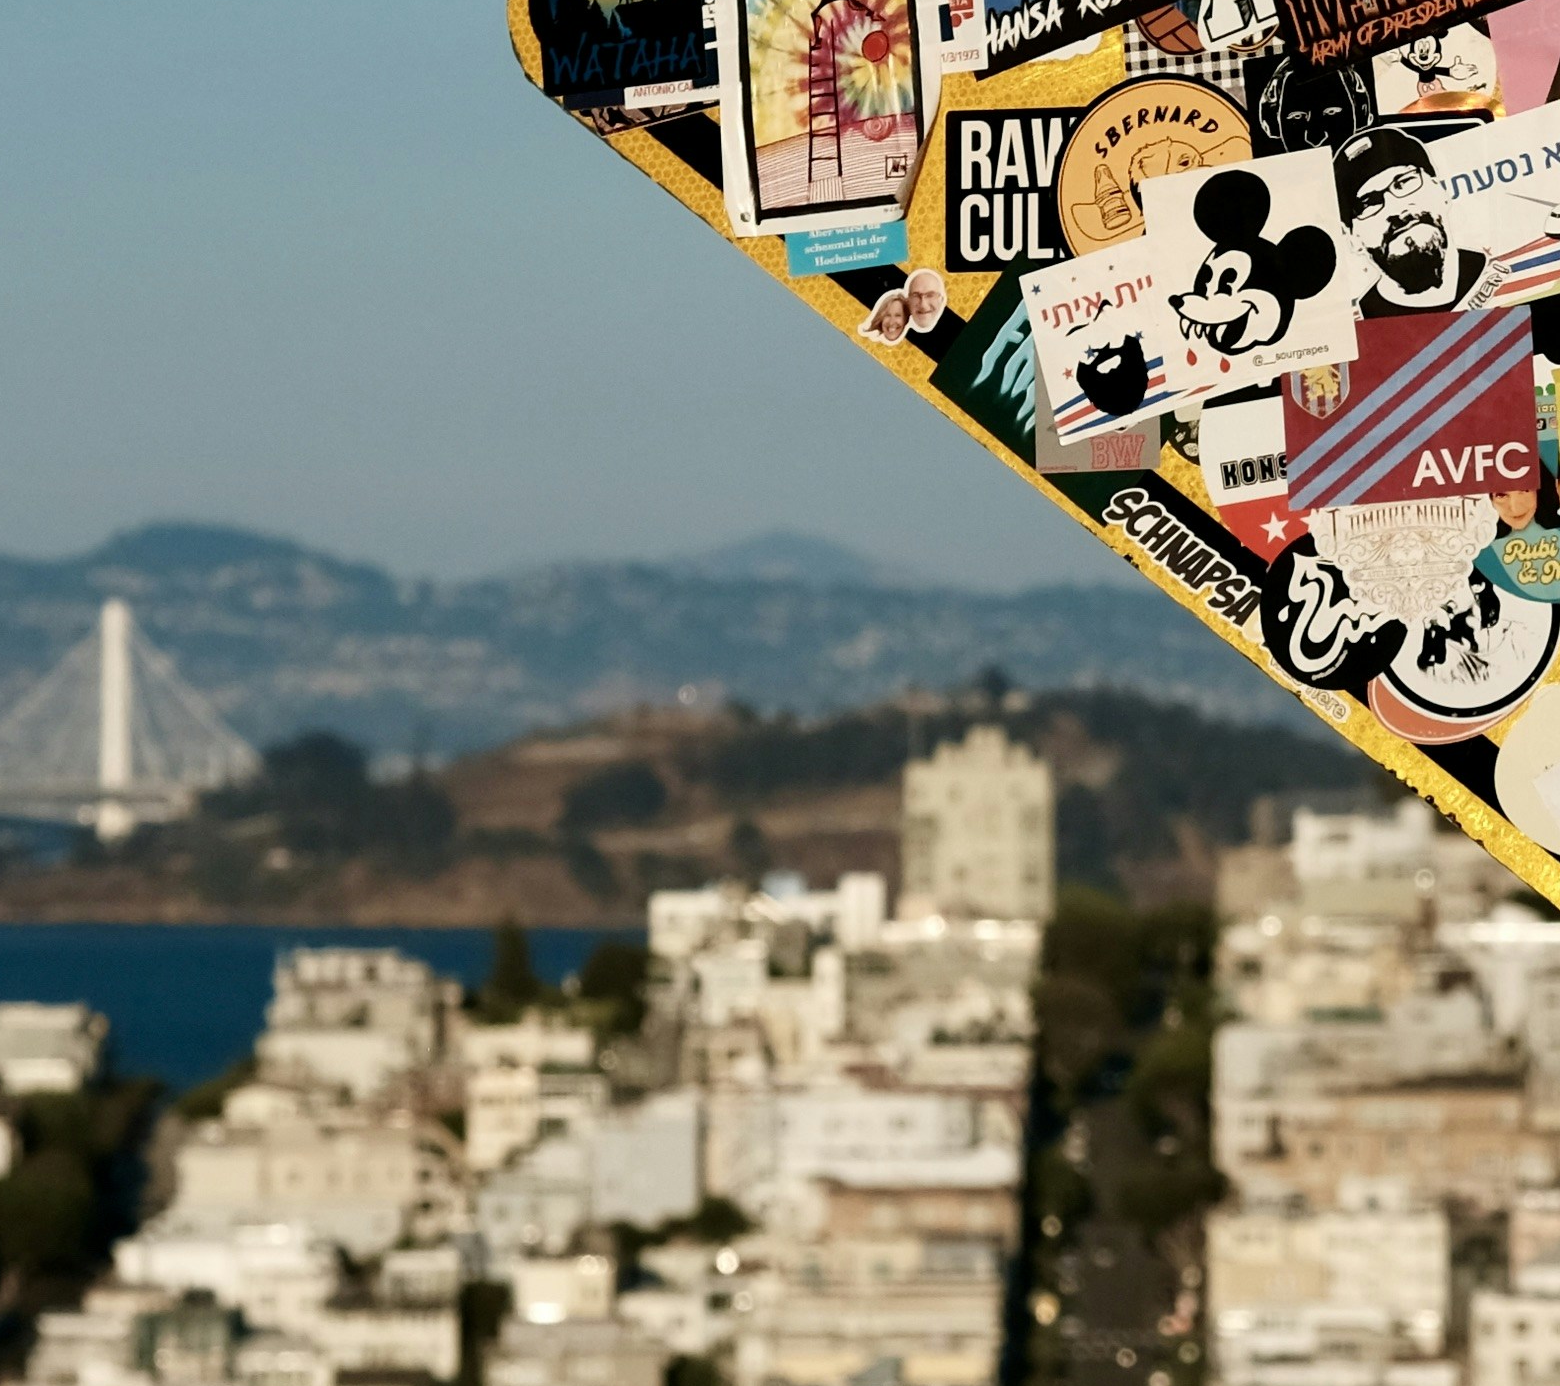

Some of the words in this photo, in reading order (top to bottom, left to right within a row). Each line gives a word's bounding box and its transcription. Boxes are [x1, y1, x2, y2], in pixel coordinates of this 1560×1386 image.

[550, 32, 702, 86] WATAHA
[1311, 30, 1351, 66] ARMY
[1095, 105, 1220, 159] SBERNARD
[1412, 441, 1531, 488] AVFC
[1503, 536, 1559, 563] Rubi
